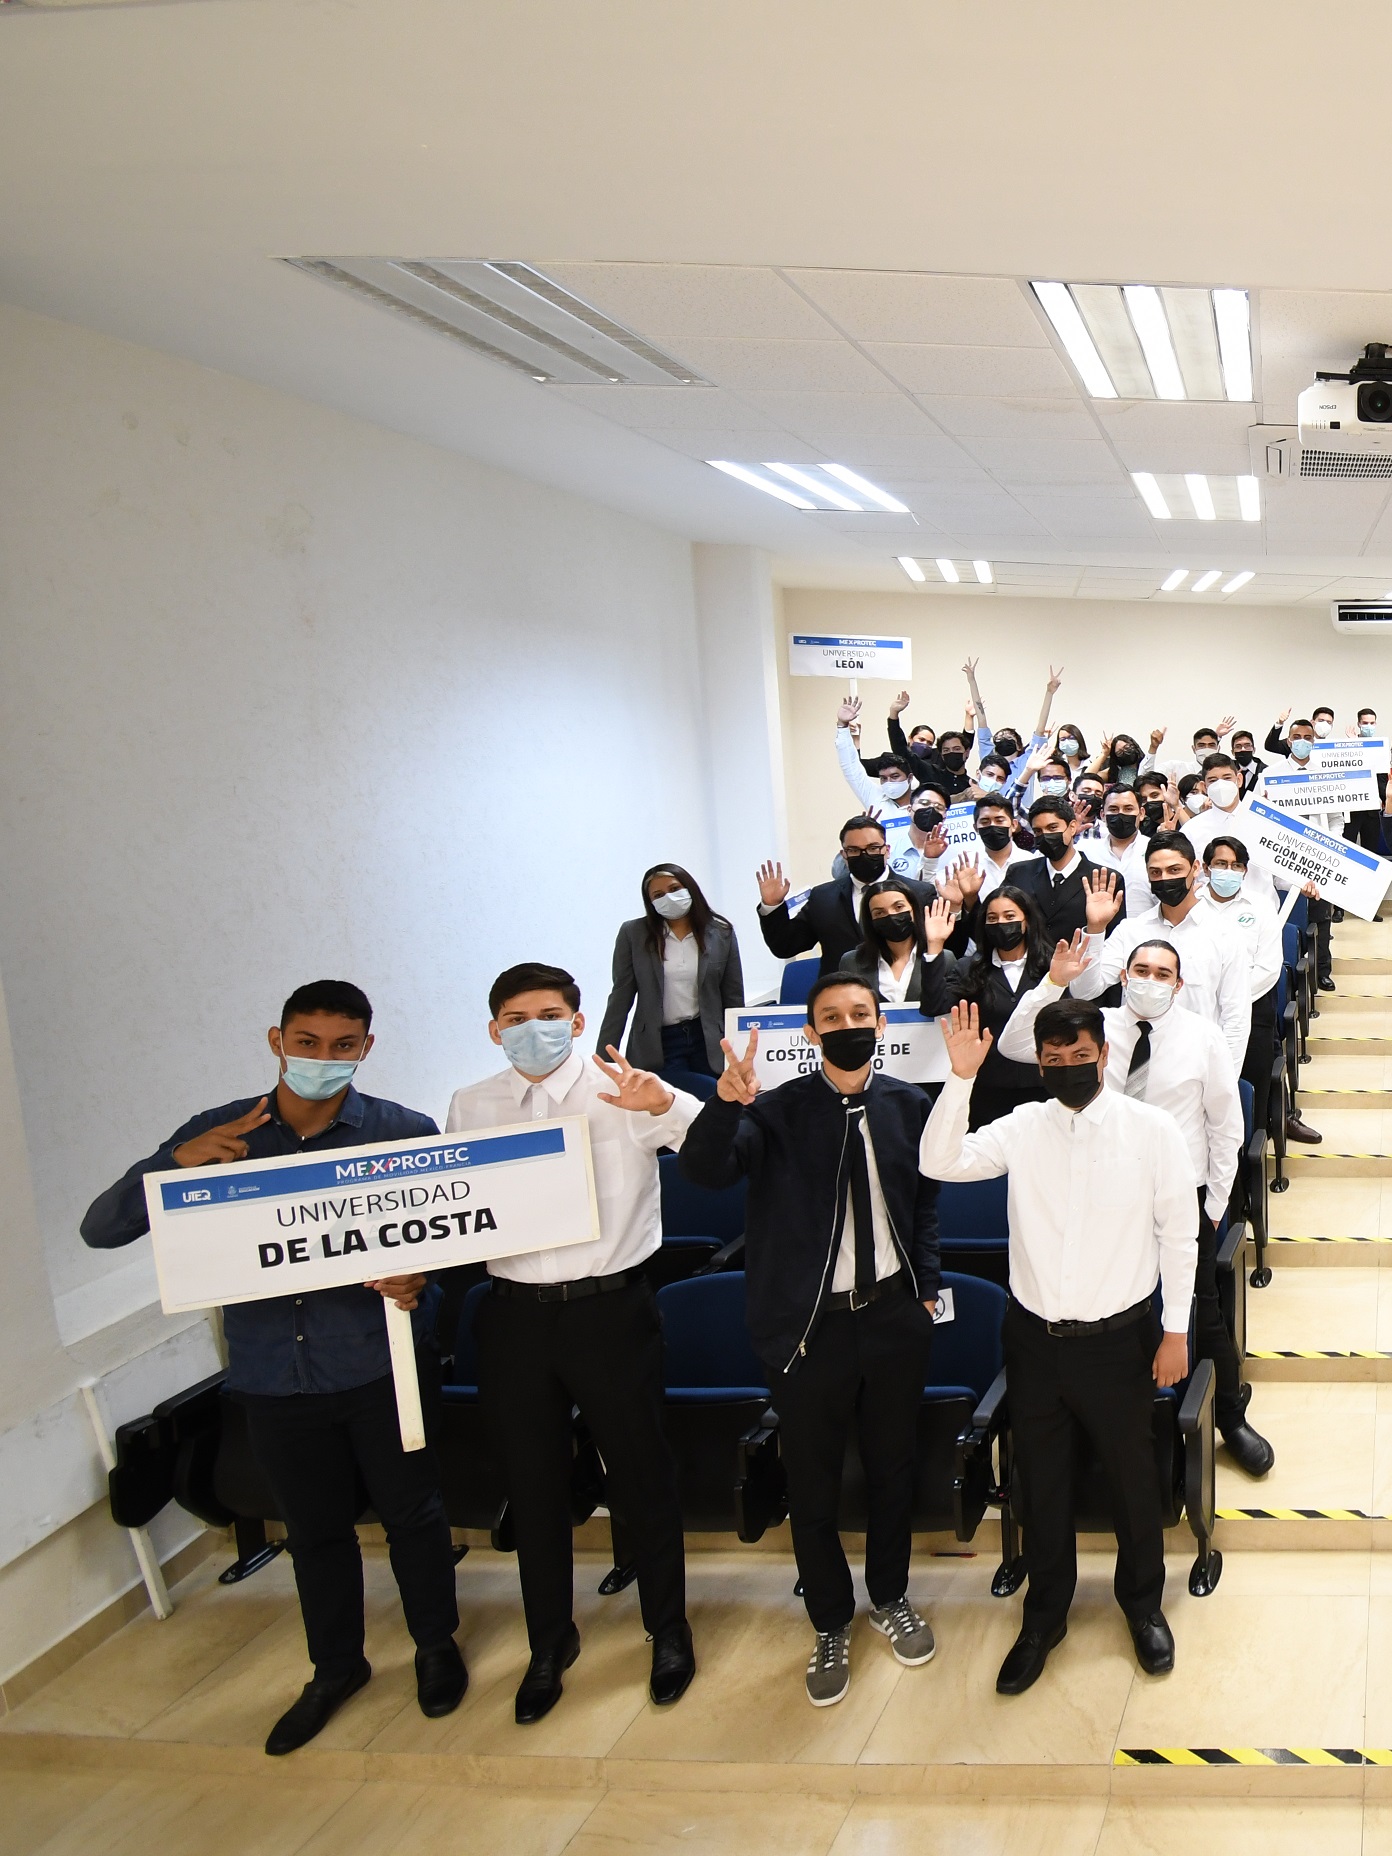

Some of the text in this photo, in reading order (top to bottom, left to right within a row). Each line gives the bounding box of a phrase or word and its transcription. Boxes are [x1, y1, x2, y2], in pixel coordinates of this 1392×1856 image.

[822, 648, 876, 658] UNIVERSIDAD
[835, 657, 864, 669] LEÓN
[1321, 750, 1364, 759] UNIVERSIDAD
[1321, 759, 1363, 769] DURANGO
[1293, 783, 1346, 794] UNIVERSIDAD
[1337, 792, 1370, 803] NORTE
[1277, 831, 1341, 868] UNIVERSIDAD
[1303, 827, 1349, 854] MEXPROTEC
[1259, 836, 1349, 886] REGIÓN NORTE DE
[1273, 855, 1328, 886] GUERRERO
[766, 1048, 816, 1062] COSTA
[890, 1043, 911, 1056] DE
[335, 1147, 470, 1180] MEXPROTEC
[337, 1175, 371, 1185] PROGRAMA
[383, 1169, 418, 1178] MOVILIDAD
[277, 1181, 470, 1227] UNIVERSIDAD
[258, 1207, 498, 1269] DE LA COSTA
